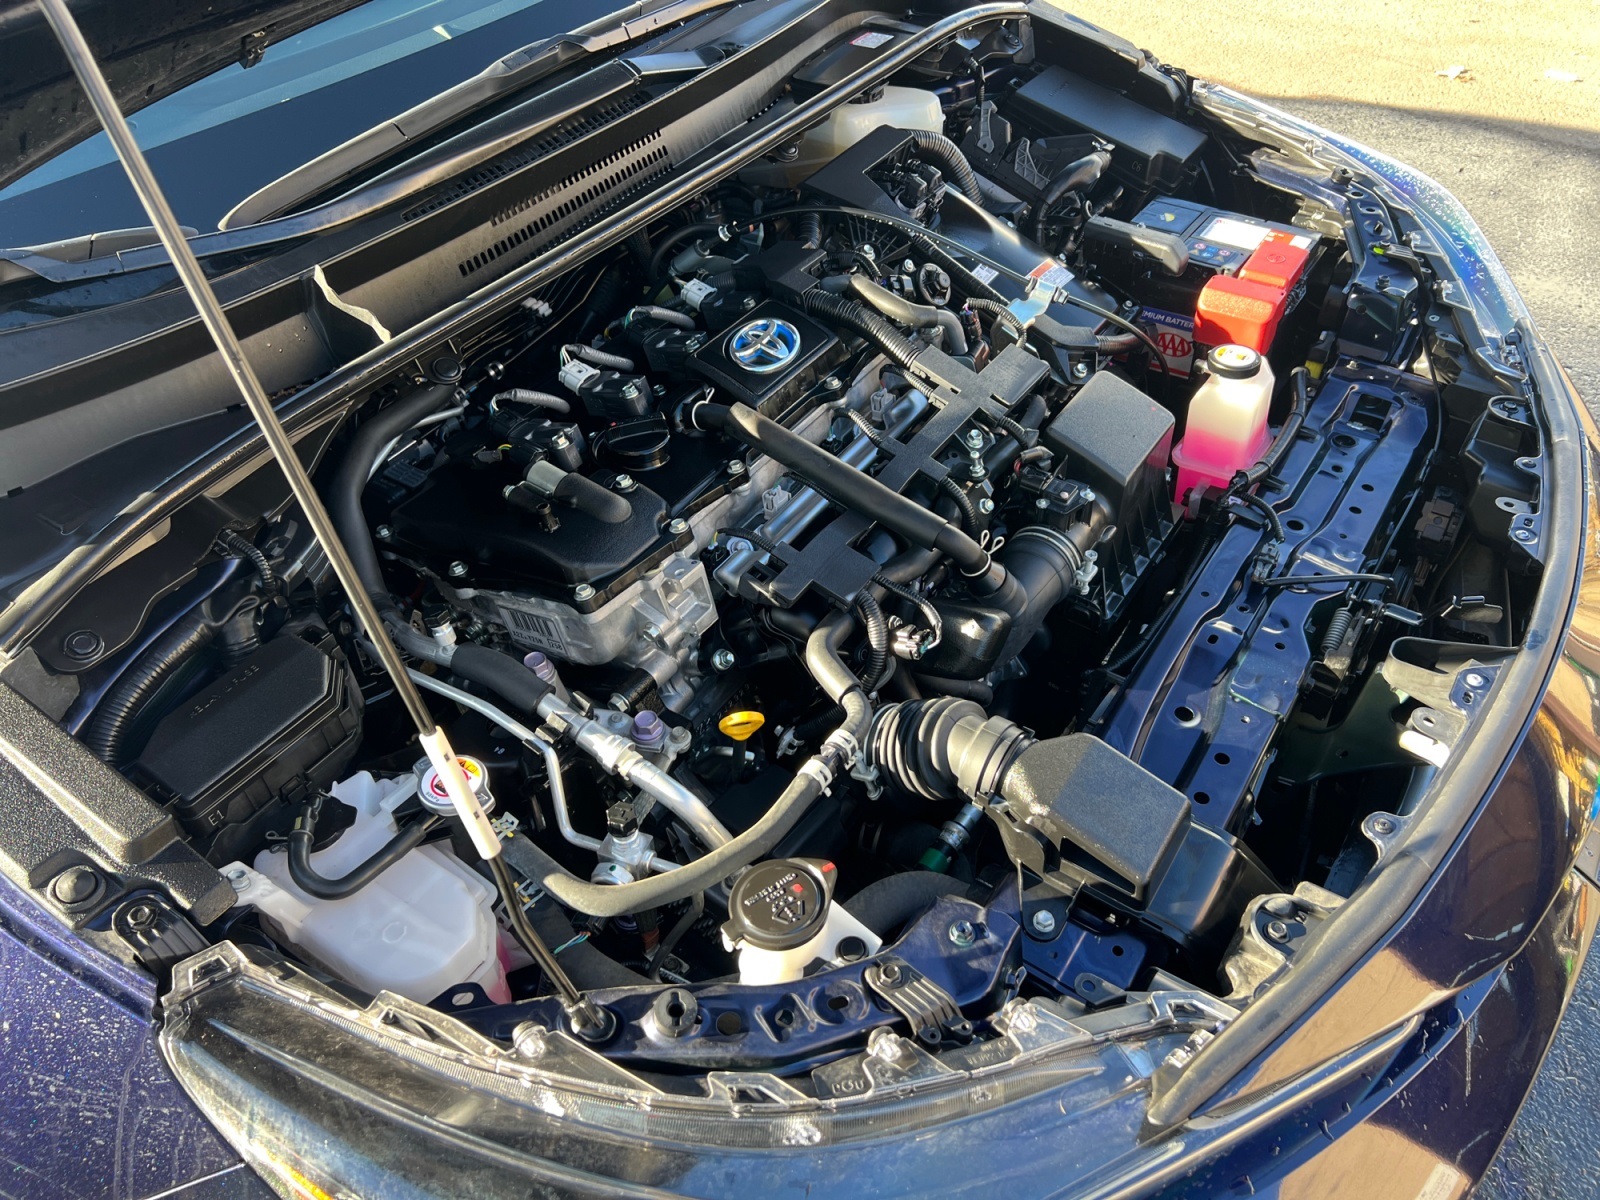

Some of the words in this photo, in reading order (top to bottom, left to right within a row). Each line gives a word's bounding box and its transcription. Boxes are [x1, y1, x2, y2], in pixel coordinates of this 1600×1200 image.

[1142, 310, 1165, 321] EMIUM
[1165, 316, 1195, 329] BATTER
[1157, 333, 1190, 357] AAA
[208, 809, 225, 826] E1
